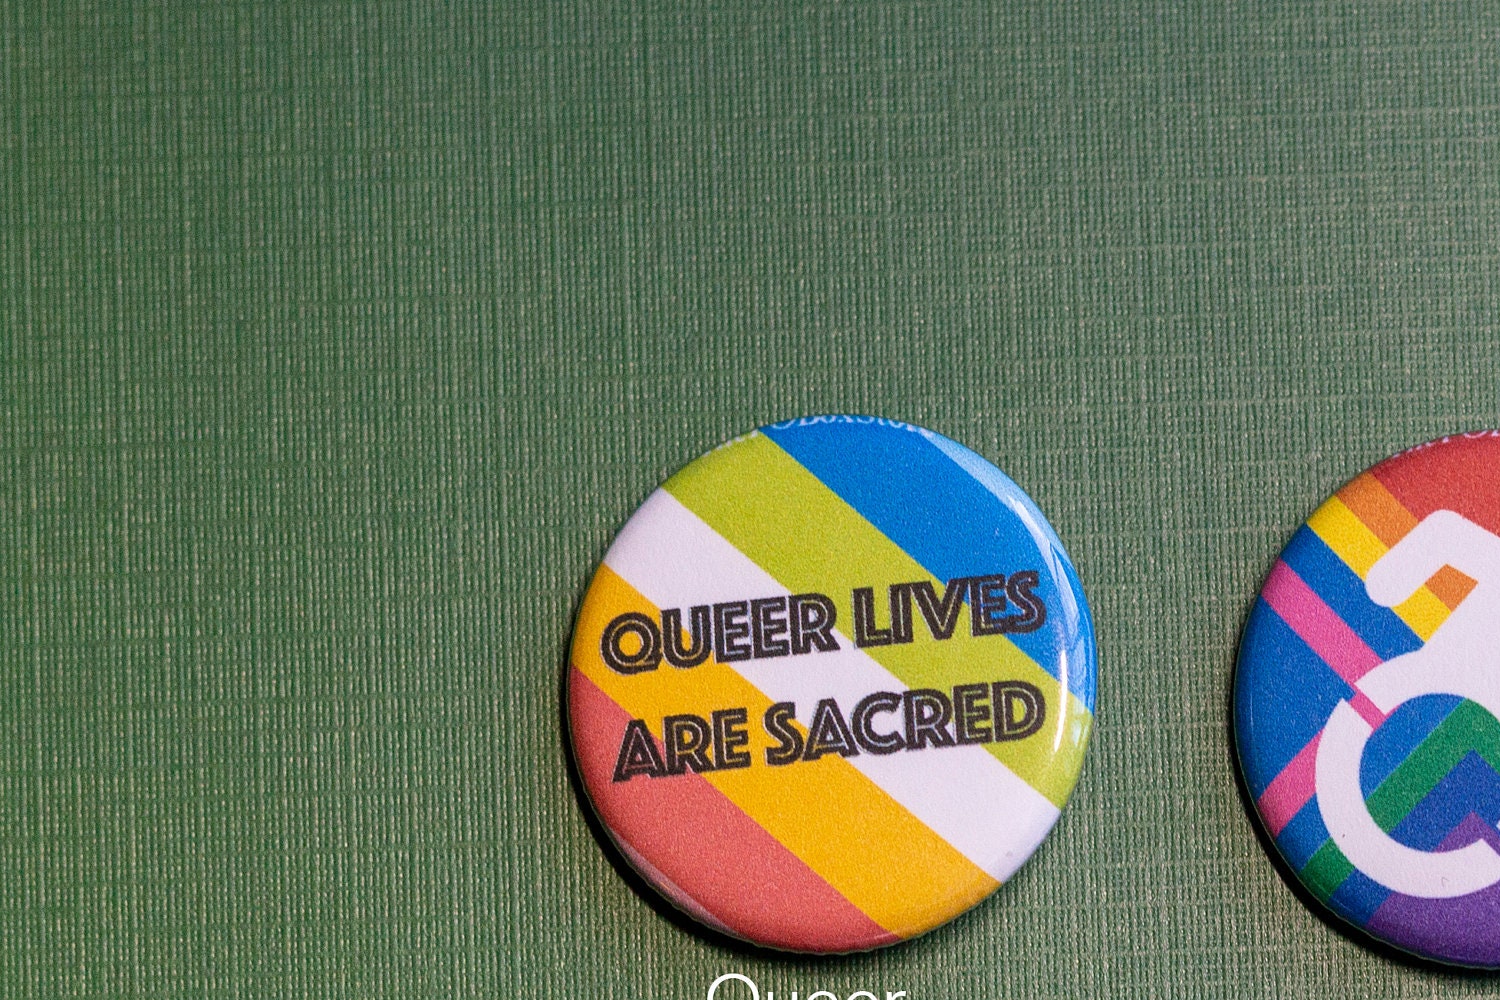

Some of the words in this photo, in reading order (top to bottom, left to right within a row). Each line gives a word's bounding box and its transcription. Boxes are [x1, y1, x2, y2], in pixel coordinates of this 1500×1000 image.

[600, 592, 839, 676] QUEER
[852, 570, 1048, 650] LIVES
[612, 707, 752, 784] ARE
[763, 679, 1047, 768] SACRED
